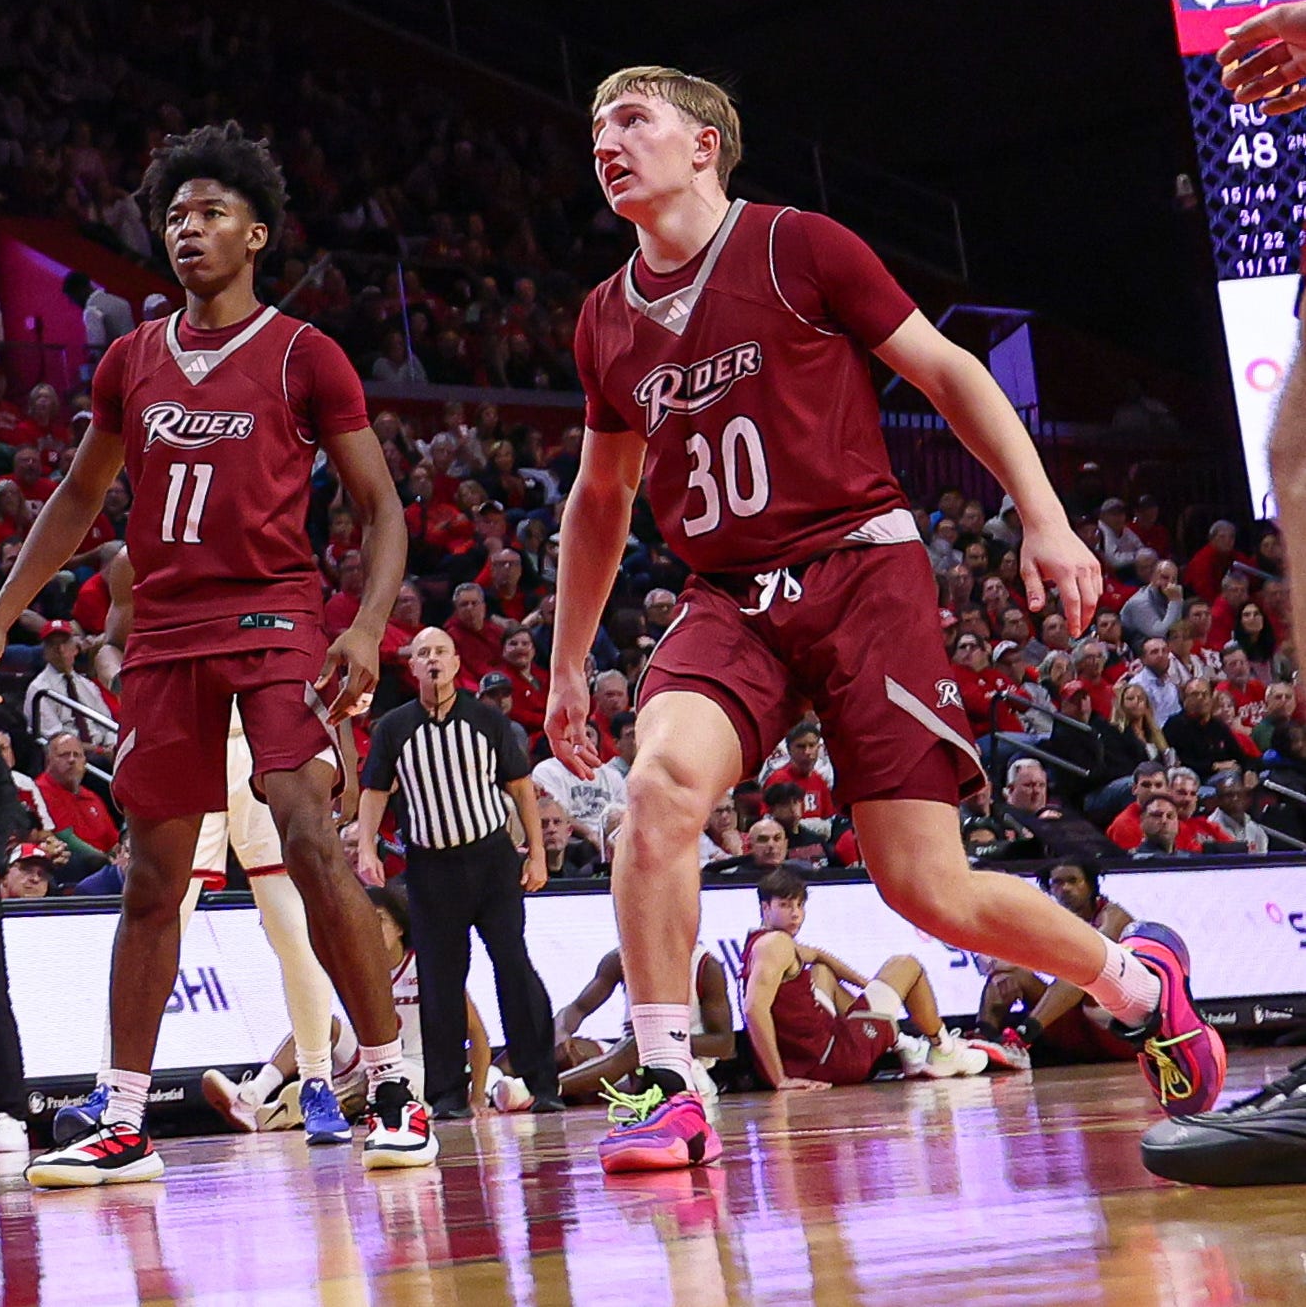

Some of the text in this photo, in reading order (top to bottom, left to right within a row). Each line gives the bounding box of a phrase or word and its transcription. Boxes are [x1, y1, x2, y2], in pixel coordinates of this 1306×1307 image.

[1227, 131, 1278, 170] 48
[141, 401, 255, 453] RIDER
[682, 415, 769, 537] 30
[161, 462, 214, 543] 11
[46, 1093, 90, 1110] Prudenti
